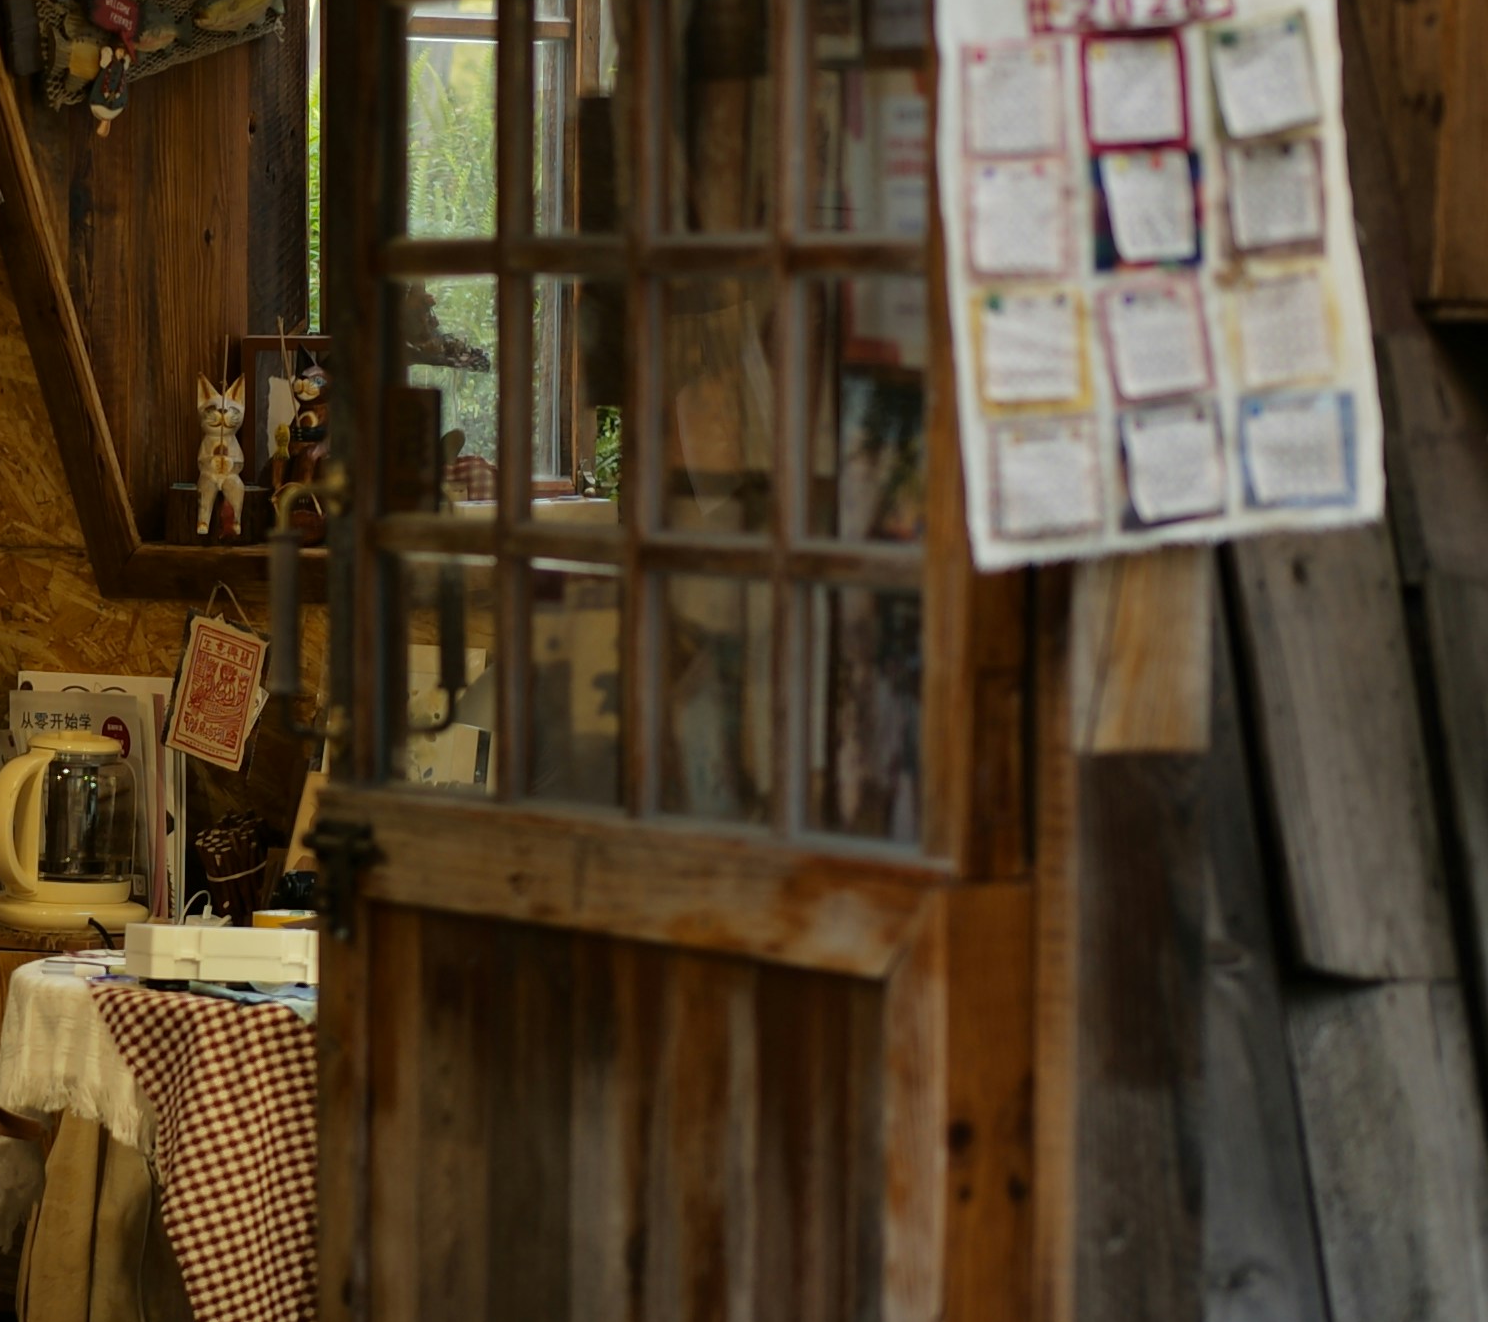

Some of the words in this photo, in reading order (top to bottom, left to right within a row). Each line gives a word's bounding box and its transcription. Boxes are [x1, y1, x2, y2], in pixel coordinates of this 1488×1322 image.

[109, 12, 133, 31] FRIENDS
[20, 711, 92, 730] 从零开始学
